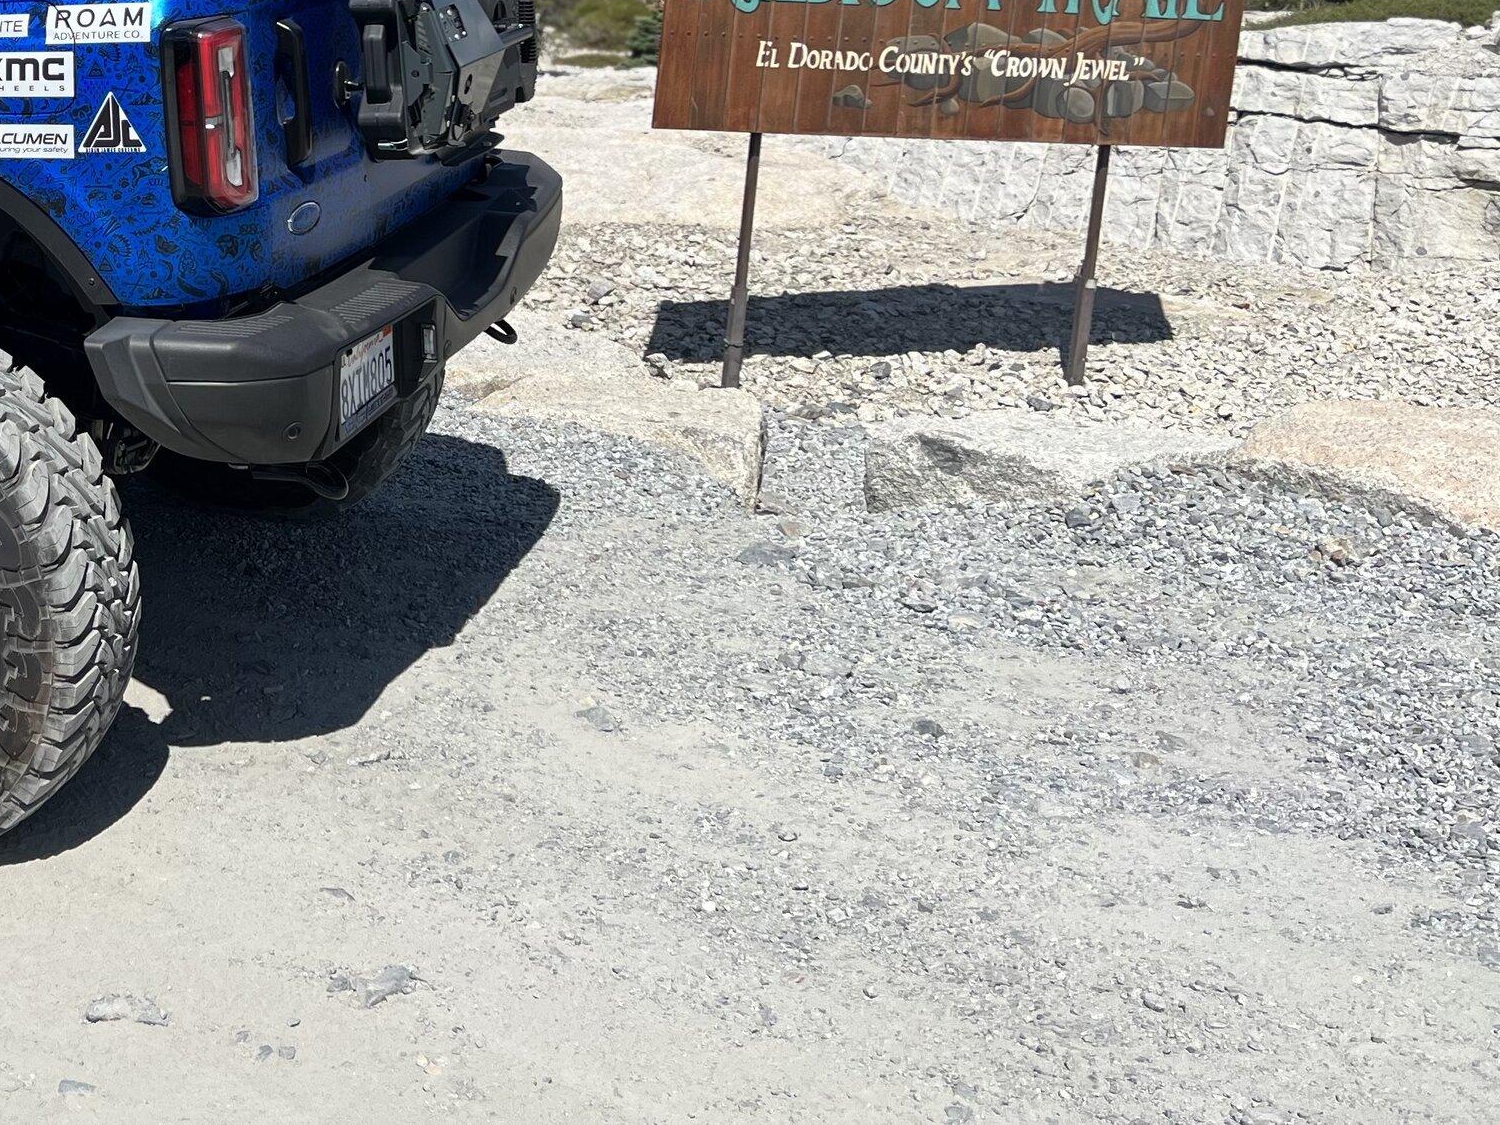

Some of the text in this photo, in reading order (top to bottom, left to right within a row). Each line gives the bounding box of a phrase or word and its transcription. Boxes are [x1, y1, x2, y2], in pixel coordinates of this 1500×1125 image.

[54, 6, 144, 29] ROAM
[53, 29, 144, 41] ADVENTURE CO.
[788, 43, 873, 72] DORADO
[22, 146, 41, 154] your
[41, 146, 69, 154] safety
